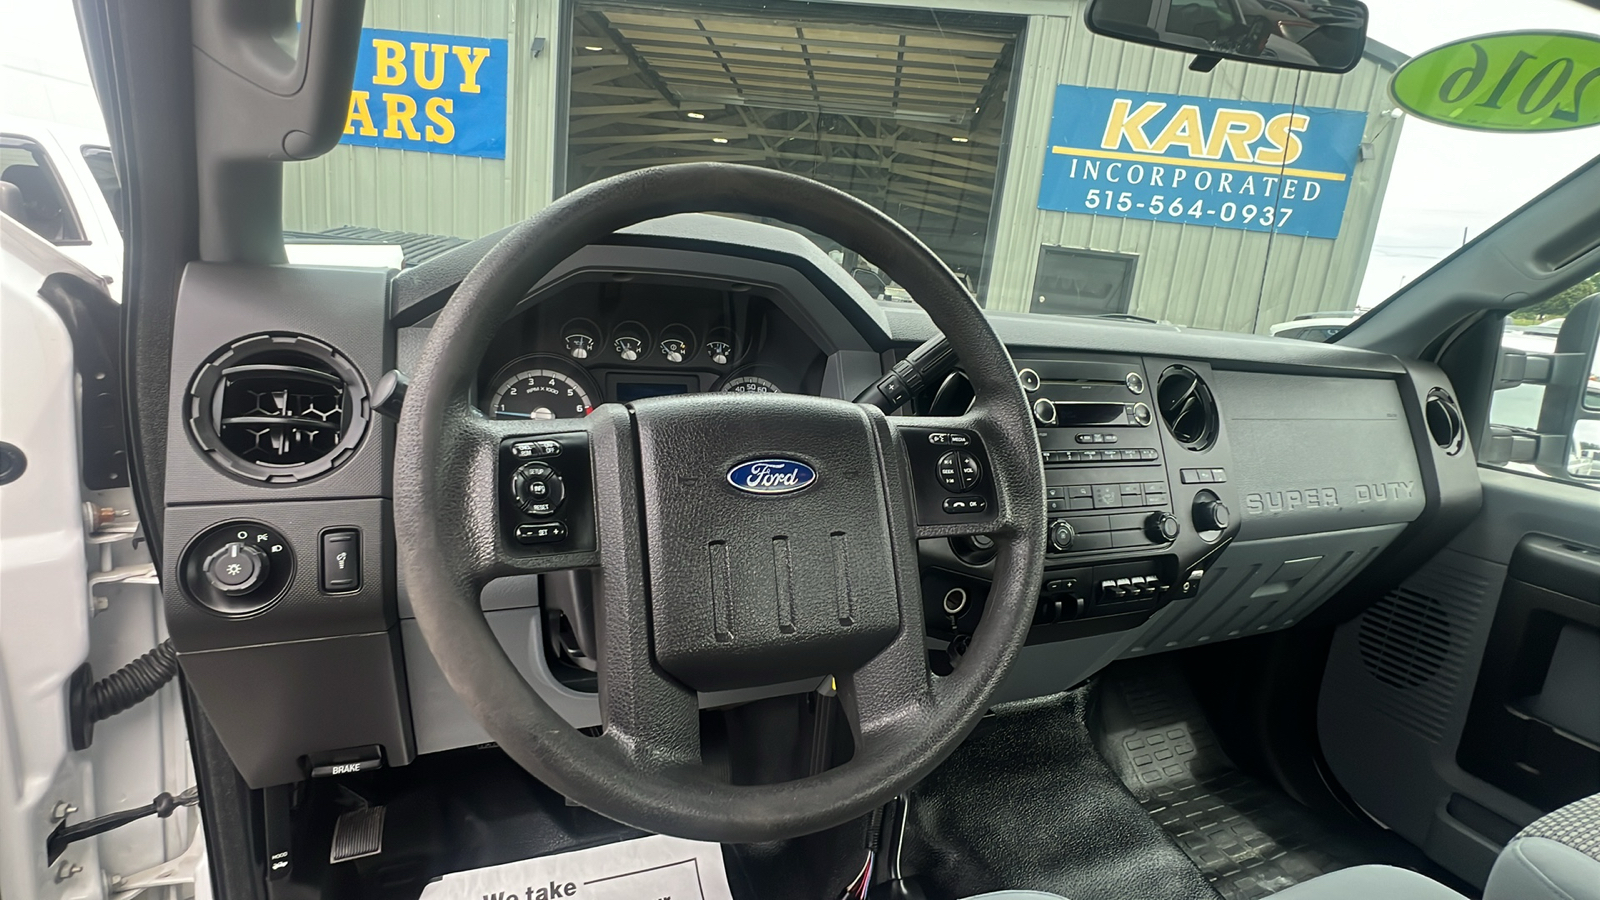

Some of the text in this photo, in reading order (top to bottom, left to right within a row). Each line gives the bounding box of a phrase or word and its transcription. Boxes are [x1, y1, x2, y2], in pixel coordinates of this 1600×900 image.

[372, 38, 490, 94] BUY
[343, 90, 455, 144] ARS
[1101, 98, 1310, 166] KARS
[1069, 158, 1321, 201] INCORPORATED
[1084, 189, 1293, 228] 515-564-0937
[528, 378, 535, 386] 3
[548, 378, 556, 386] 4
[746, 383, 757, 391] 50
[510, 388, 517, 396] 2
[526, 386, 540, 394] RPM
[545, 386, 559, 395] 1000
[576, 404, 583, 413] 6
[746, 463, 799, 487] Ford
[1246, 481, 1414, 515] SUPER DUTY
[332, 763, 361, 775] BRAKE
[272, 851, 289, 860] HOOD
[525, 881, 577, 900] take
